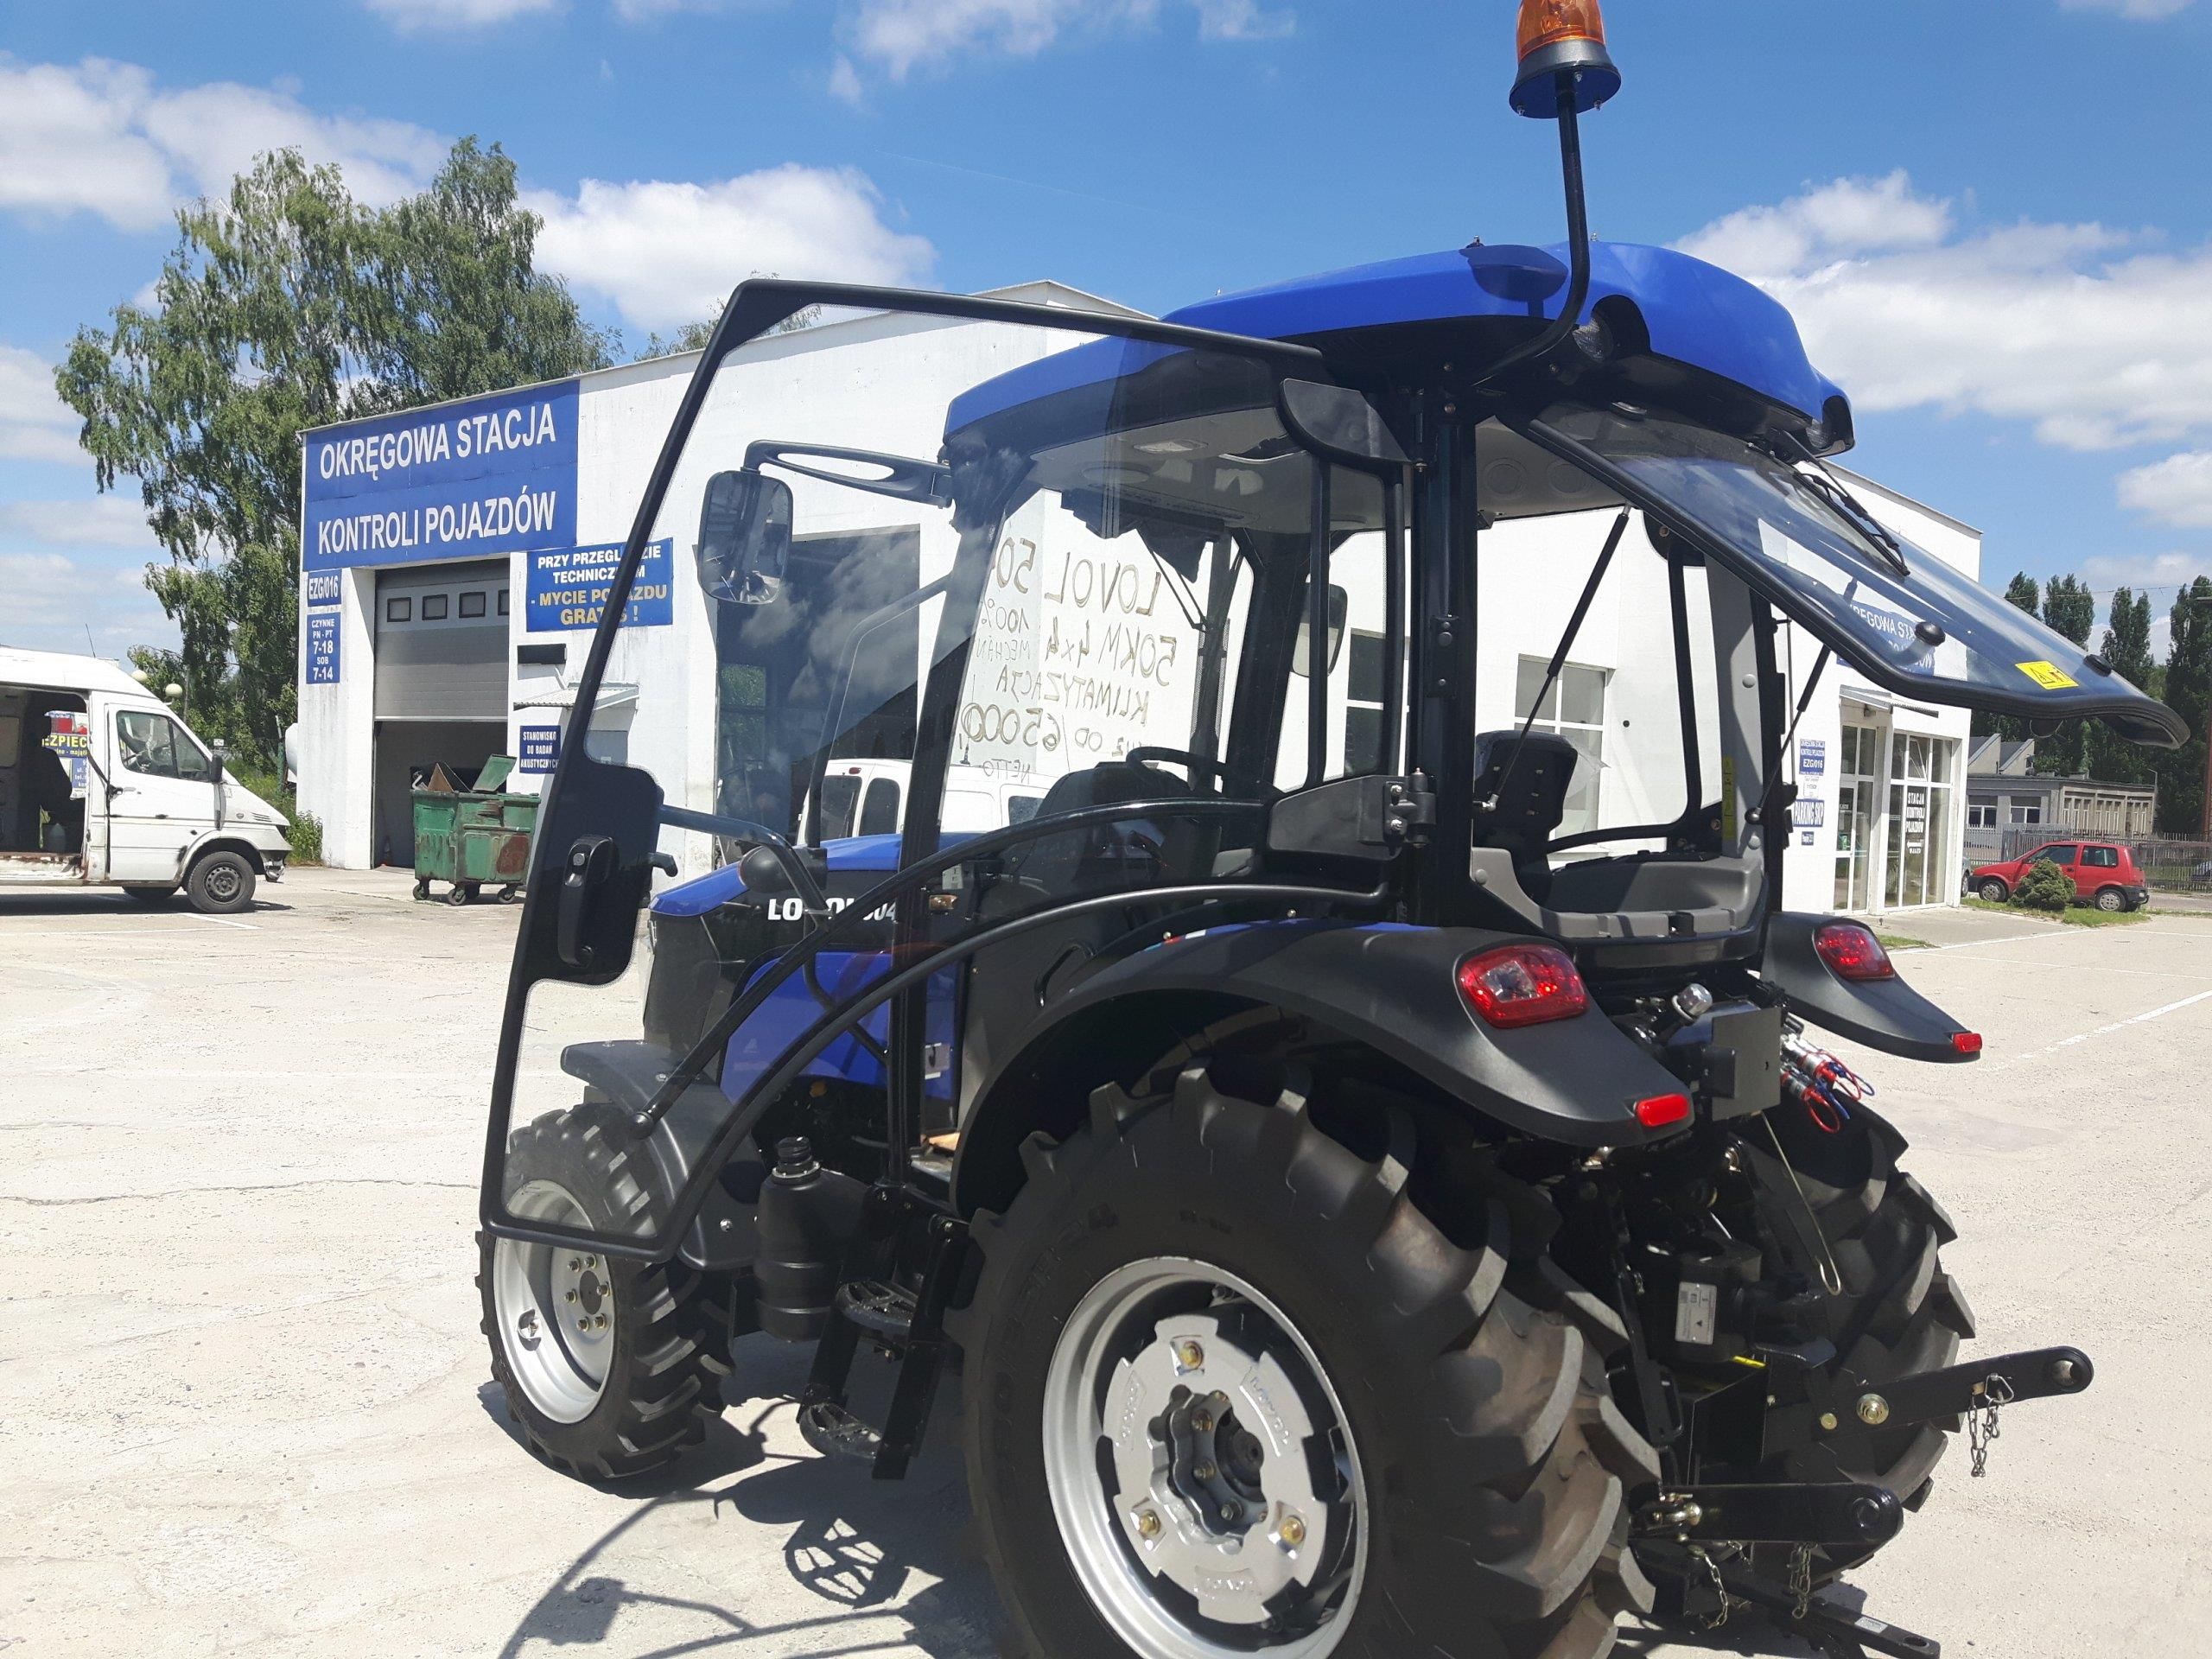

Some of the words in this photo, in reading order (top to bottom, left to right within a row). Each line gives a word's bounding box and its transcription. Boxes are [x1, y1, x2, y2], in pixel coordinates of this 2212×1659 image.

[320, 423, 450, 481] OKRĘGOWA
[456, 404, 556, 458] STACJA
[318, 509, 419, 555] KONTROLI
[425, 485, 556, 543] POJAZDÓW
[537, 554, 569, 569] PRZY
[572, 545, 662, 566] PRZEGLZIE
[553, 564, 645, 584] TECHNICZM
[308, 575, 339, 600] EZG/016
[539, 589, 587, 607] MYCIE
[591, 584, 667, 603] POAZDU
[311, 618, 335, 628] CZYNNE
[560, 607, 627, 626] GRATS
[313, 640, 334, 654] 7-18
[316, 656, 329, 664] SOB
[313, 665, 334, 680] 7-14
[523, 731, 557, 741] STANOWISKO
[527, 745, 535, 754] DO
[1907, 792, 1925, 804] STACJA
[1906, 807, 1925, 818] KONTROLI
[768, 898, 855, 921] LOO
[863, 901, 897, 921] 04
